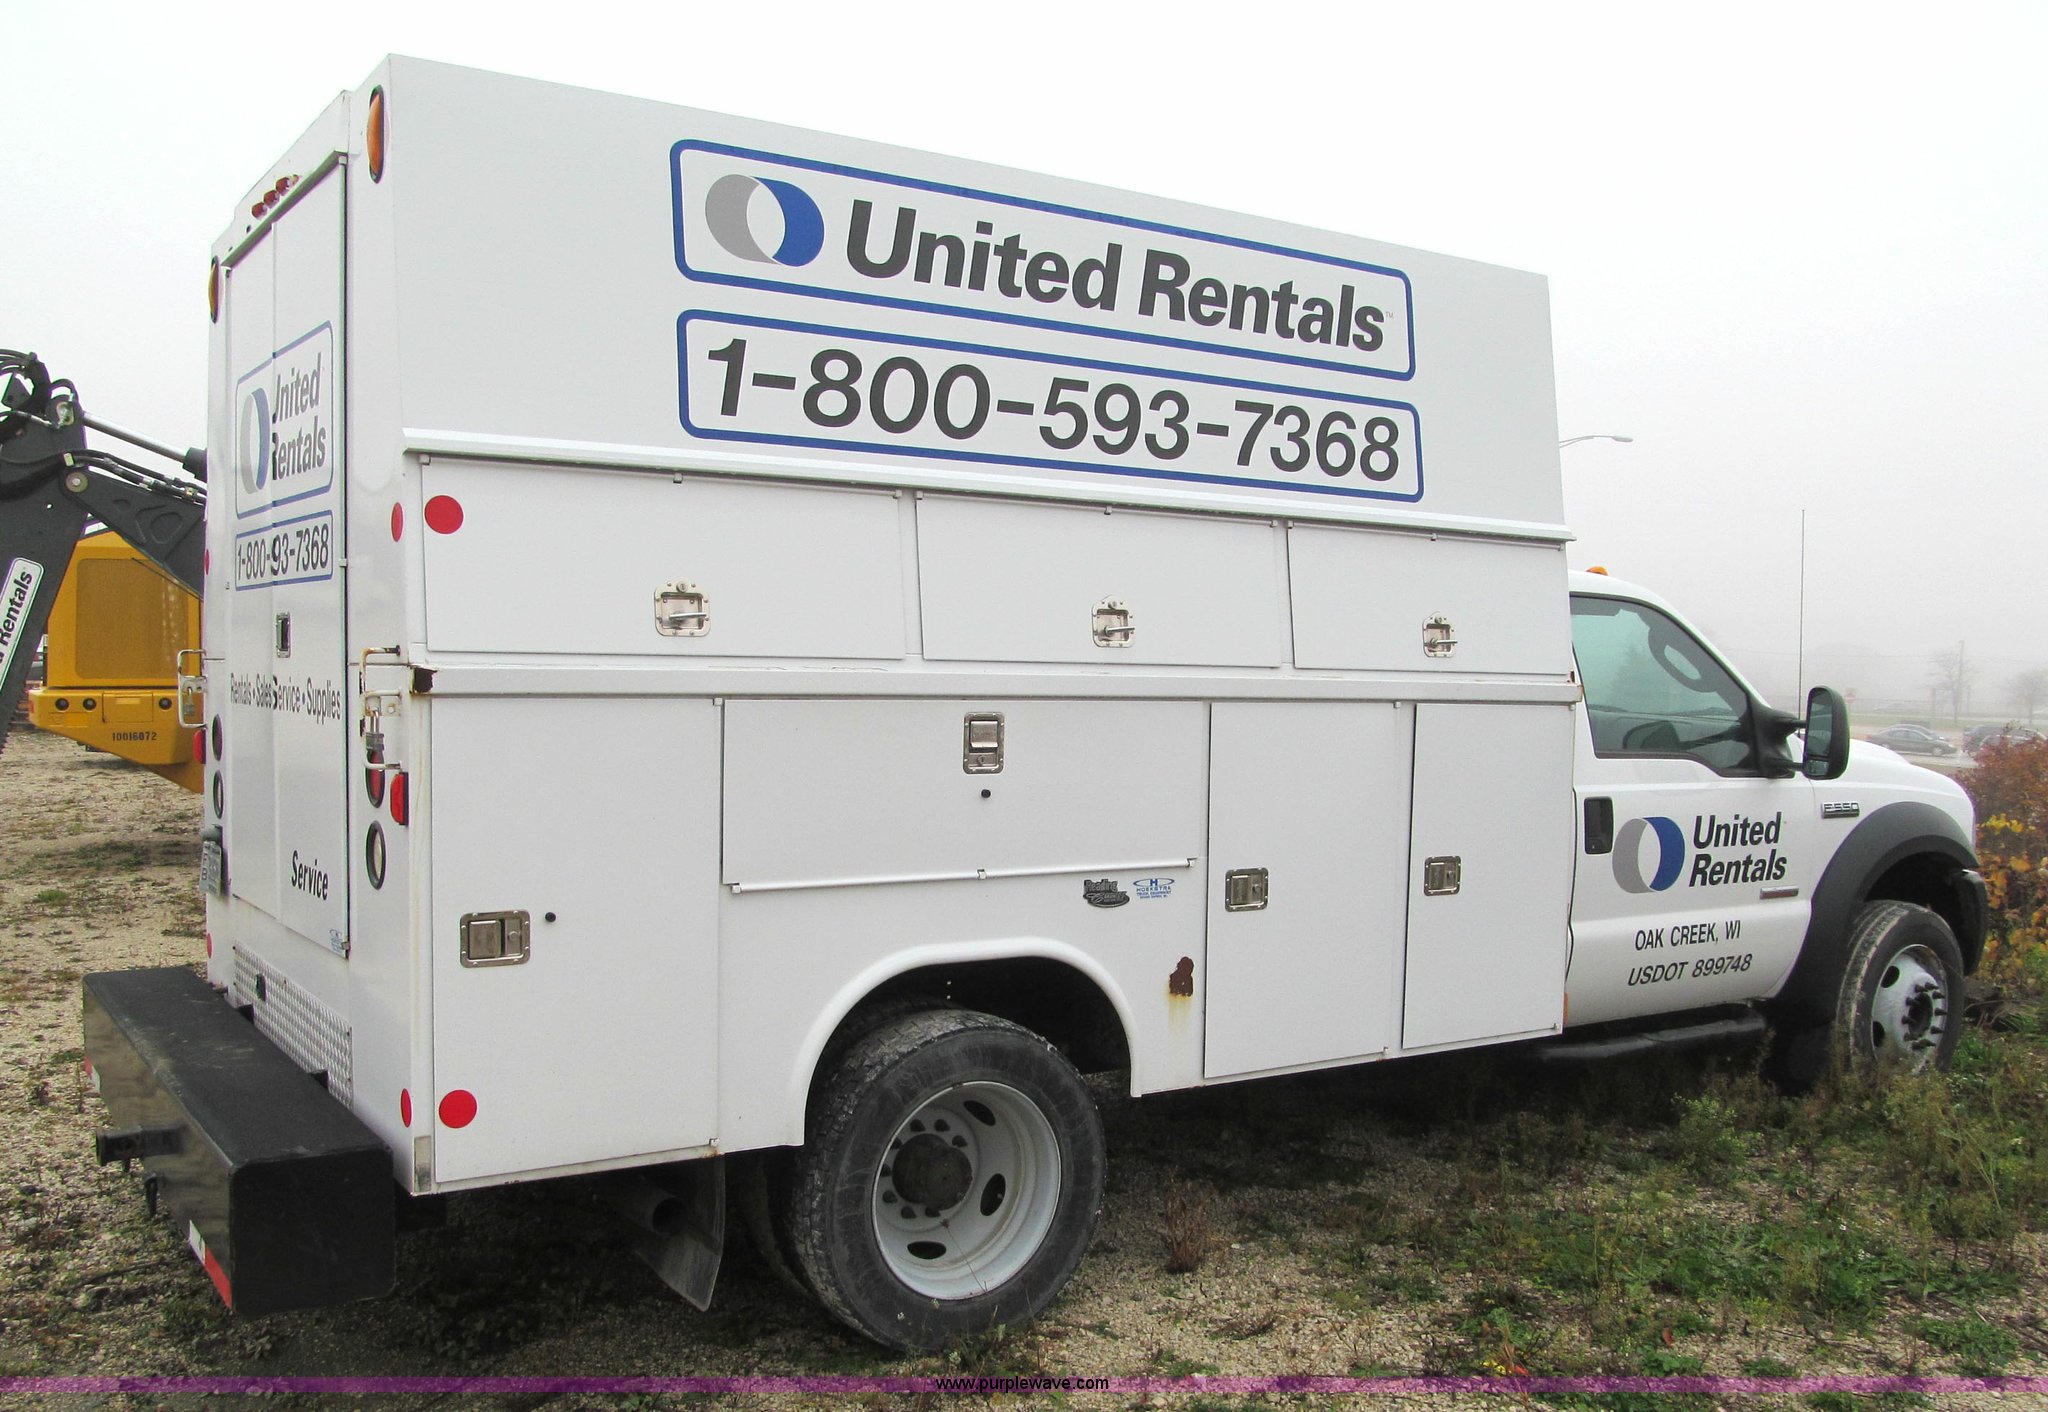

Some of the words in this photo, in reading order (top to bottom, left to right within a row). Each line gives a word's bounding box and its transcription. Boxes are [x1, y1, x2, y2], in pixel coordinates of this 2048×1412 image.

[846, 199, 1122, 311] United
[1138, 249, 1385, 352] Rentals
[707, 338, 1400, 481] 1-800-593-7368
[272, 415, 326, 481] Rentals
[0, 571, 33, 646] Rentals
[256, 673, 272, 708] Sales
[306, 676, 340, 725] Supplies
[1693, 812, 1782, 849] United
[292, 850, 329, 900] Service
[1689, 849, 1787, 888] Rentals
[1635, 929, 1664, 951] OAK
[1670, 922, 1719, 947] CREEK,
[1725, 919, 1741, 940] WI
[1628, 962, 1688, 986] USDOT
[1692, 953, 1753, 978] 899748
